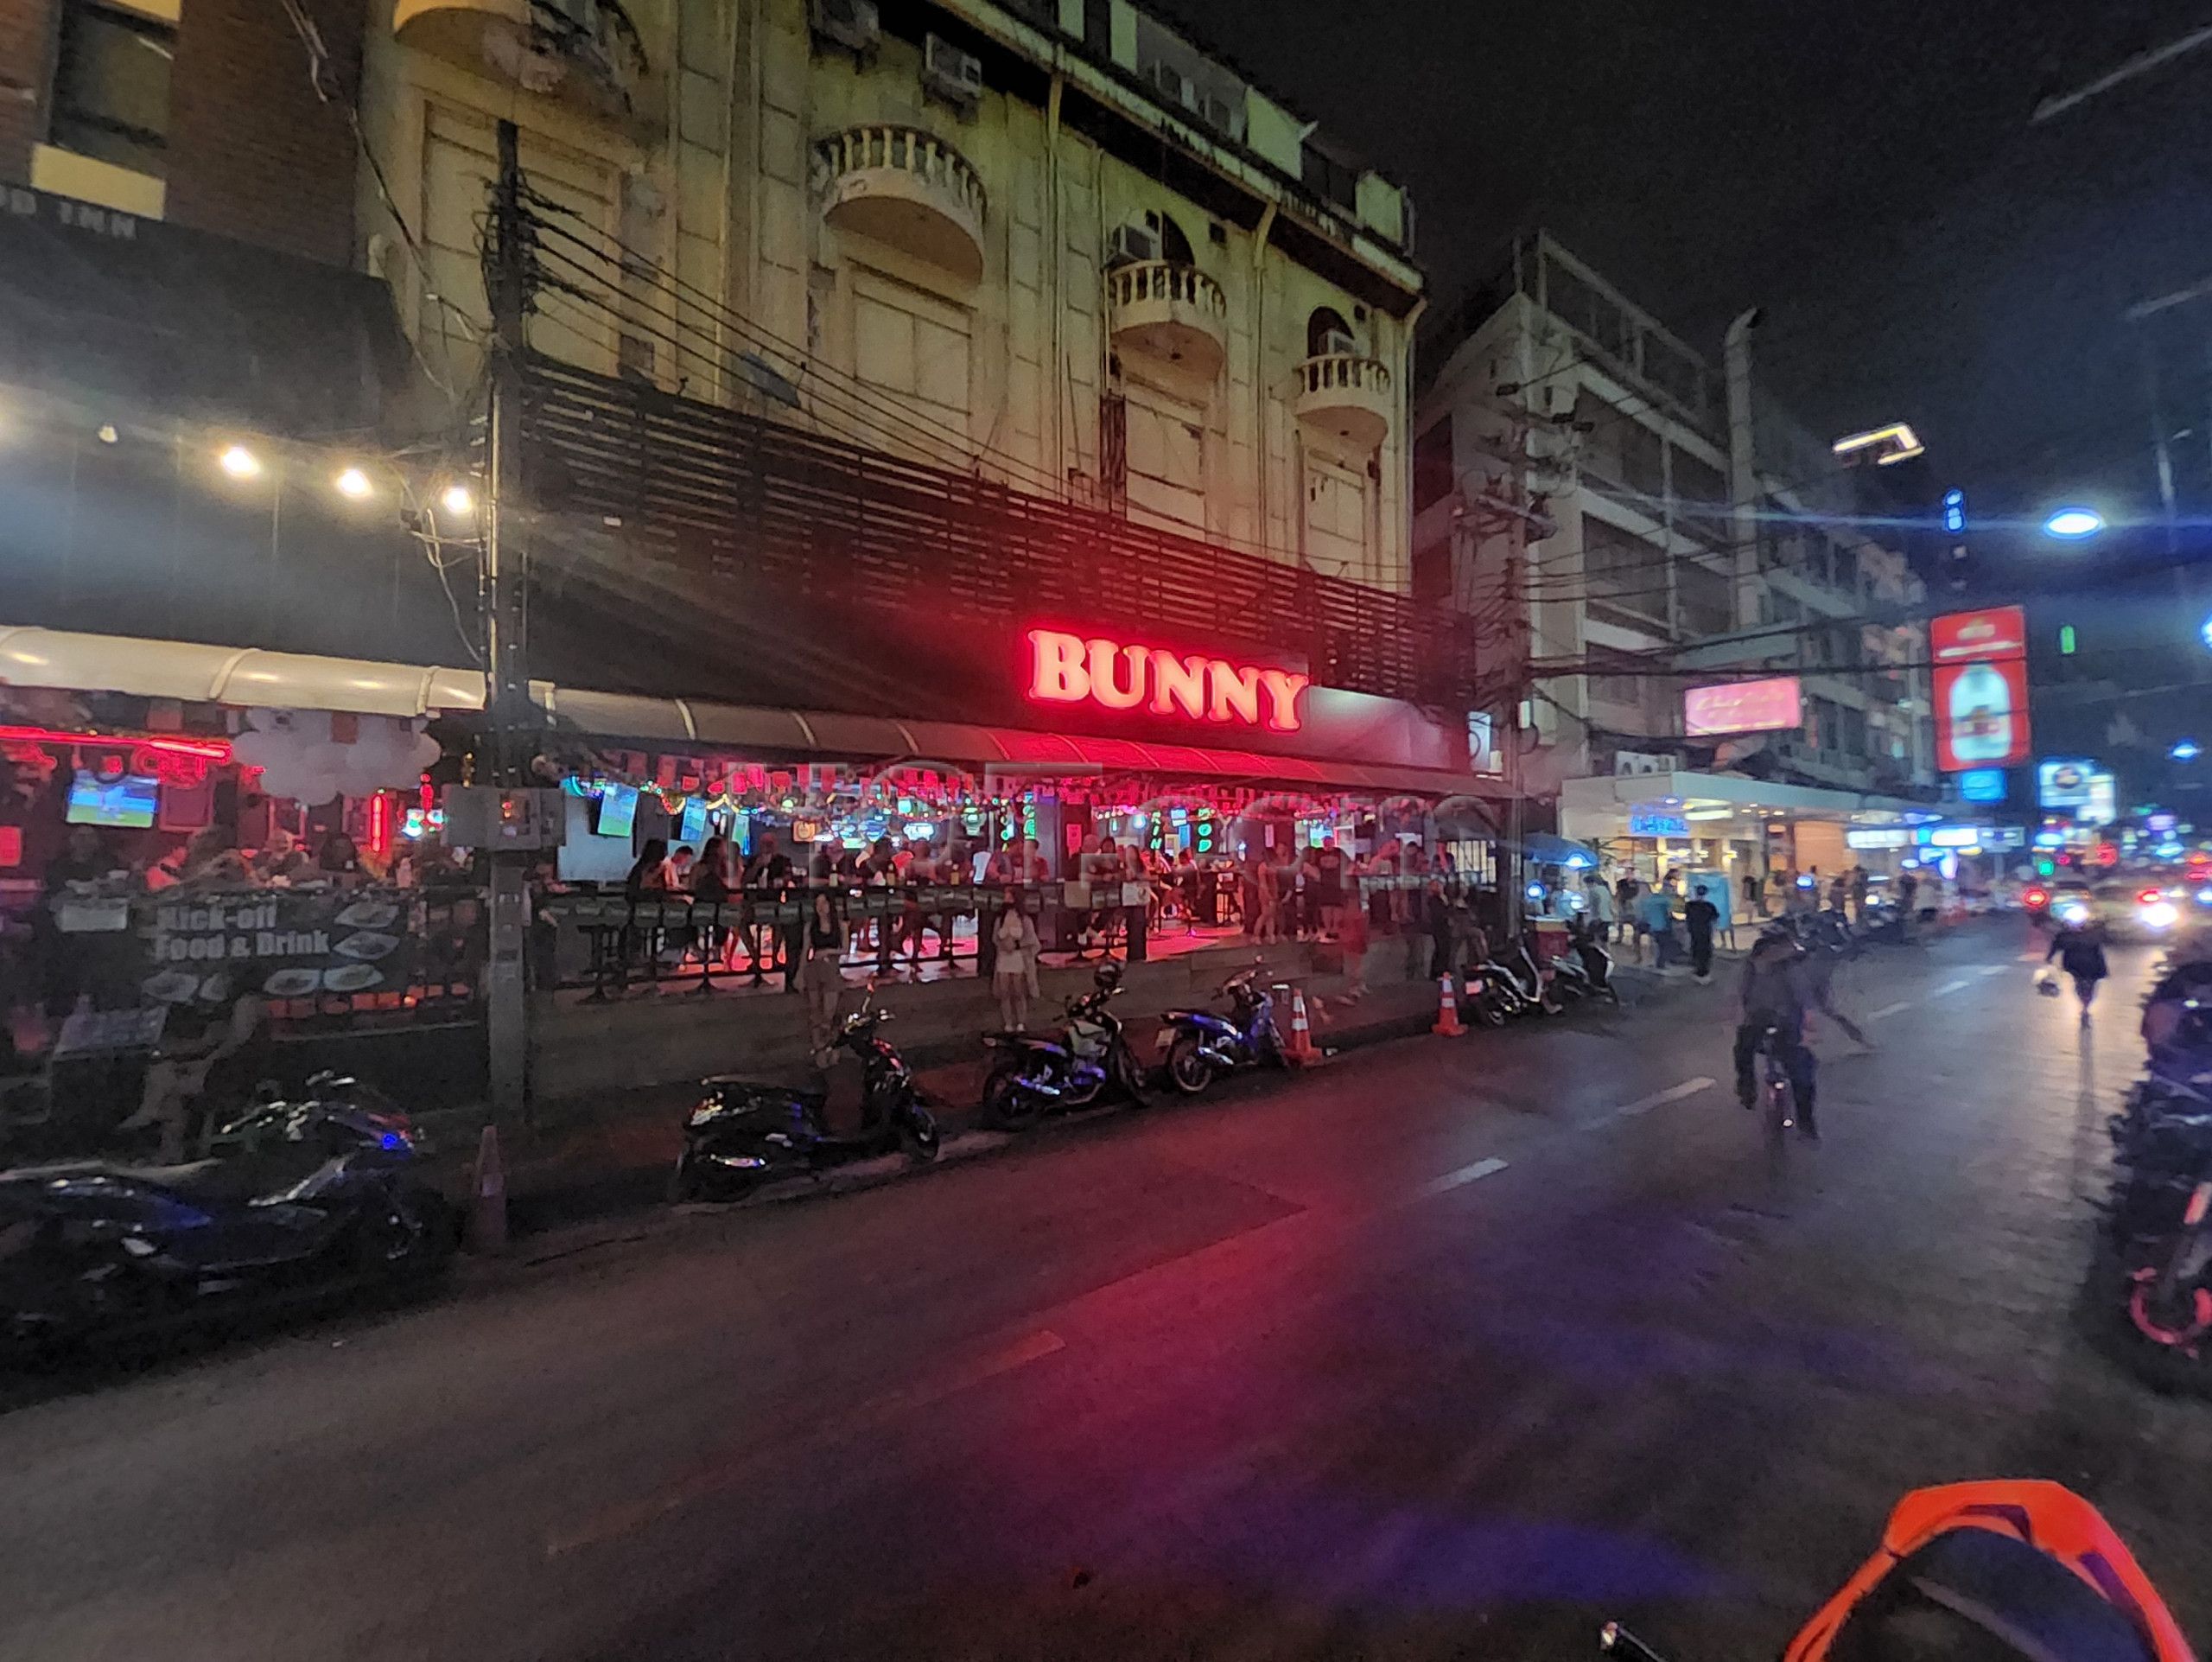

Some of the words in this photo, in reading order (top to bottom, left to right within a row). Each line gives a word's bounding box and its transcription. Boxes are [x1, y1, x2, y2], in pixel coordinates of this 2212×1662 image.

[1027, 629, 1309, 730] BUNNY
[156, 933, 226, 961] Food
[230, 936, 251, 957] &
[256, 929, 330, 955] Drink
